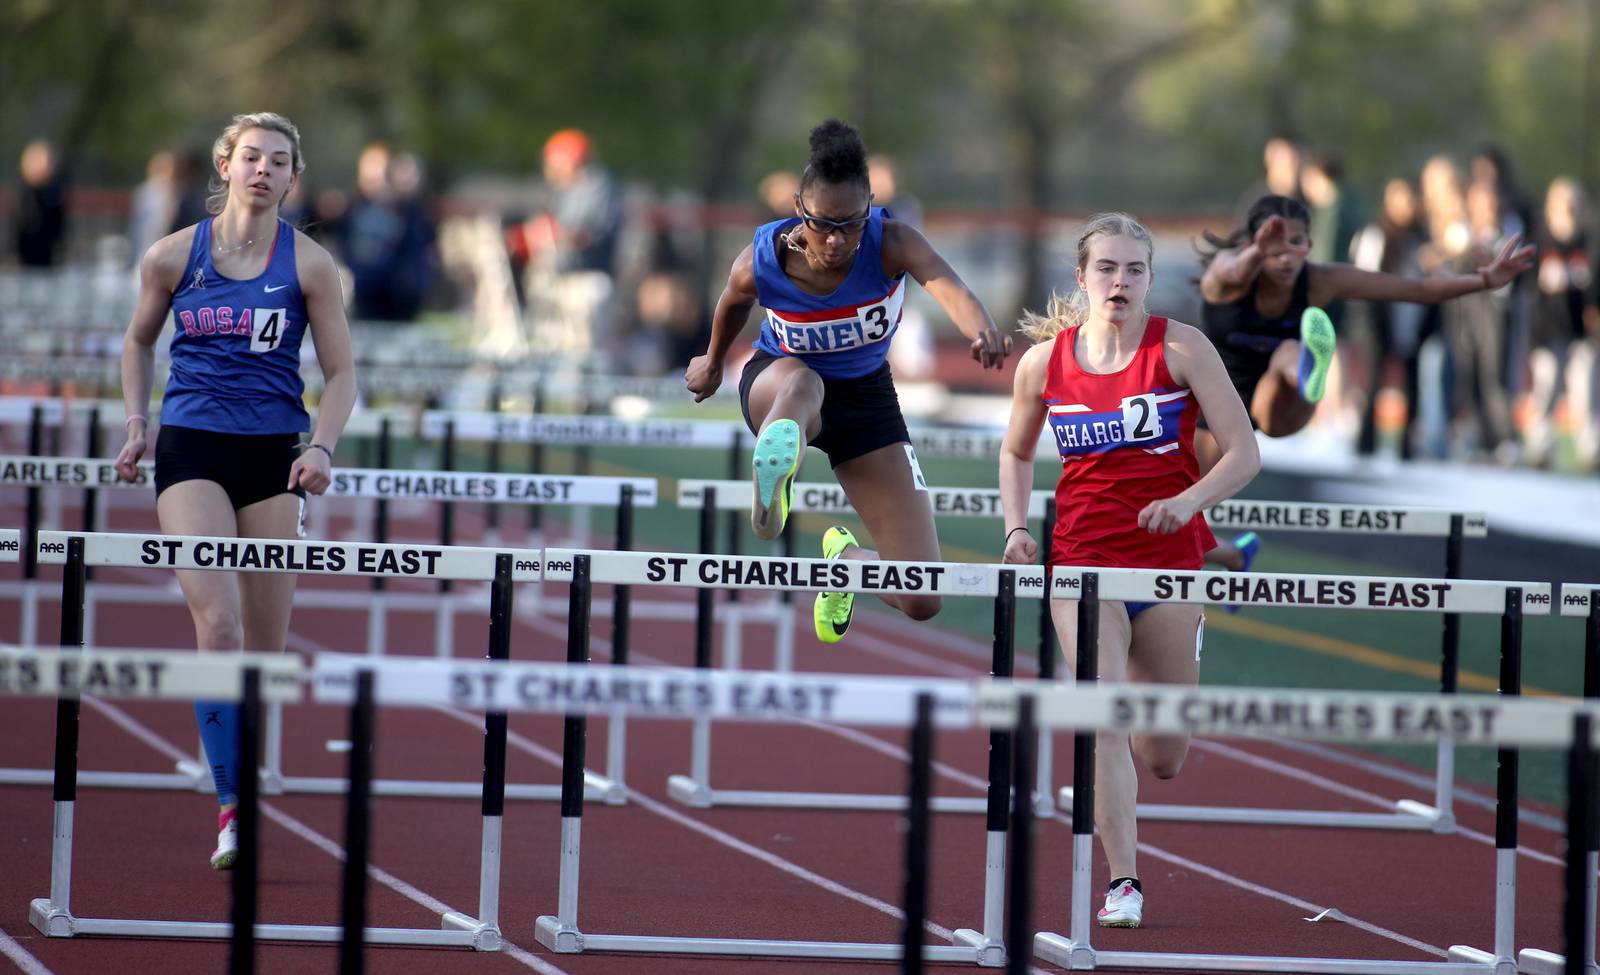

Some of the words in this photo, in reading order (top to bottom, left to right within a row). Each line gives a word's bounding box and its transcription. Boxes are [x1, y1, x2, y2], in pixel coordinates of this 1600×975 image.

[180, 306, 291, 338] ROSA
[258, 311, 280, 349] 4
[865, 305, 890, 340] 3
[1129, 397, 1154, 439] 2
[333, 473, 366, 493] ST
[376, 475, 497, 498] CHARLES
[507, 480, 574, 500] EAST
[935, 496, 1004, 513] EAST
[1209, 504, 1331, 528] CHARLES
[1341, 510, 1407, 530] EAST
[140, 539, 183, 566] ST
[193, 541, 346, 572] CHARLES
[357, 548, 442, 576] EAST
[646, 557, 688, 583] ST
[699, 558, 850, 590] CHARLES
[861, 563, 944, 592] EAST
[1154, 574, 1195, 600] ST
[1205, 576, 1356, 606] CHARLES
[1367, 582, 1451, 609] EAST
[57, 660, 167, 692] EAST
[450, 671, 500, 701] ST
[516, 673, 712, 712] CHARLES
[732, 682, 840, 715] EAST
[1111, 696, 1163, 726] ST
[1178, 698, 1374, 736] CHARLES
[1393, 704, 1498, 738] EAST
